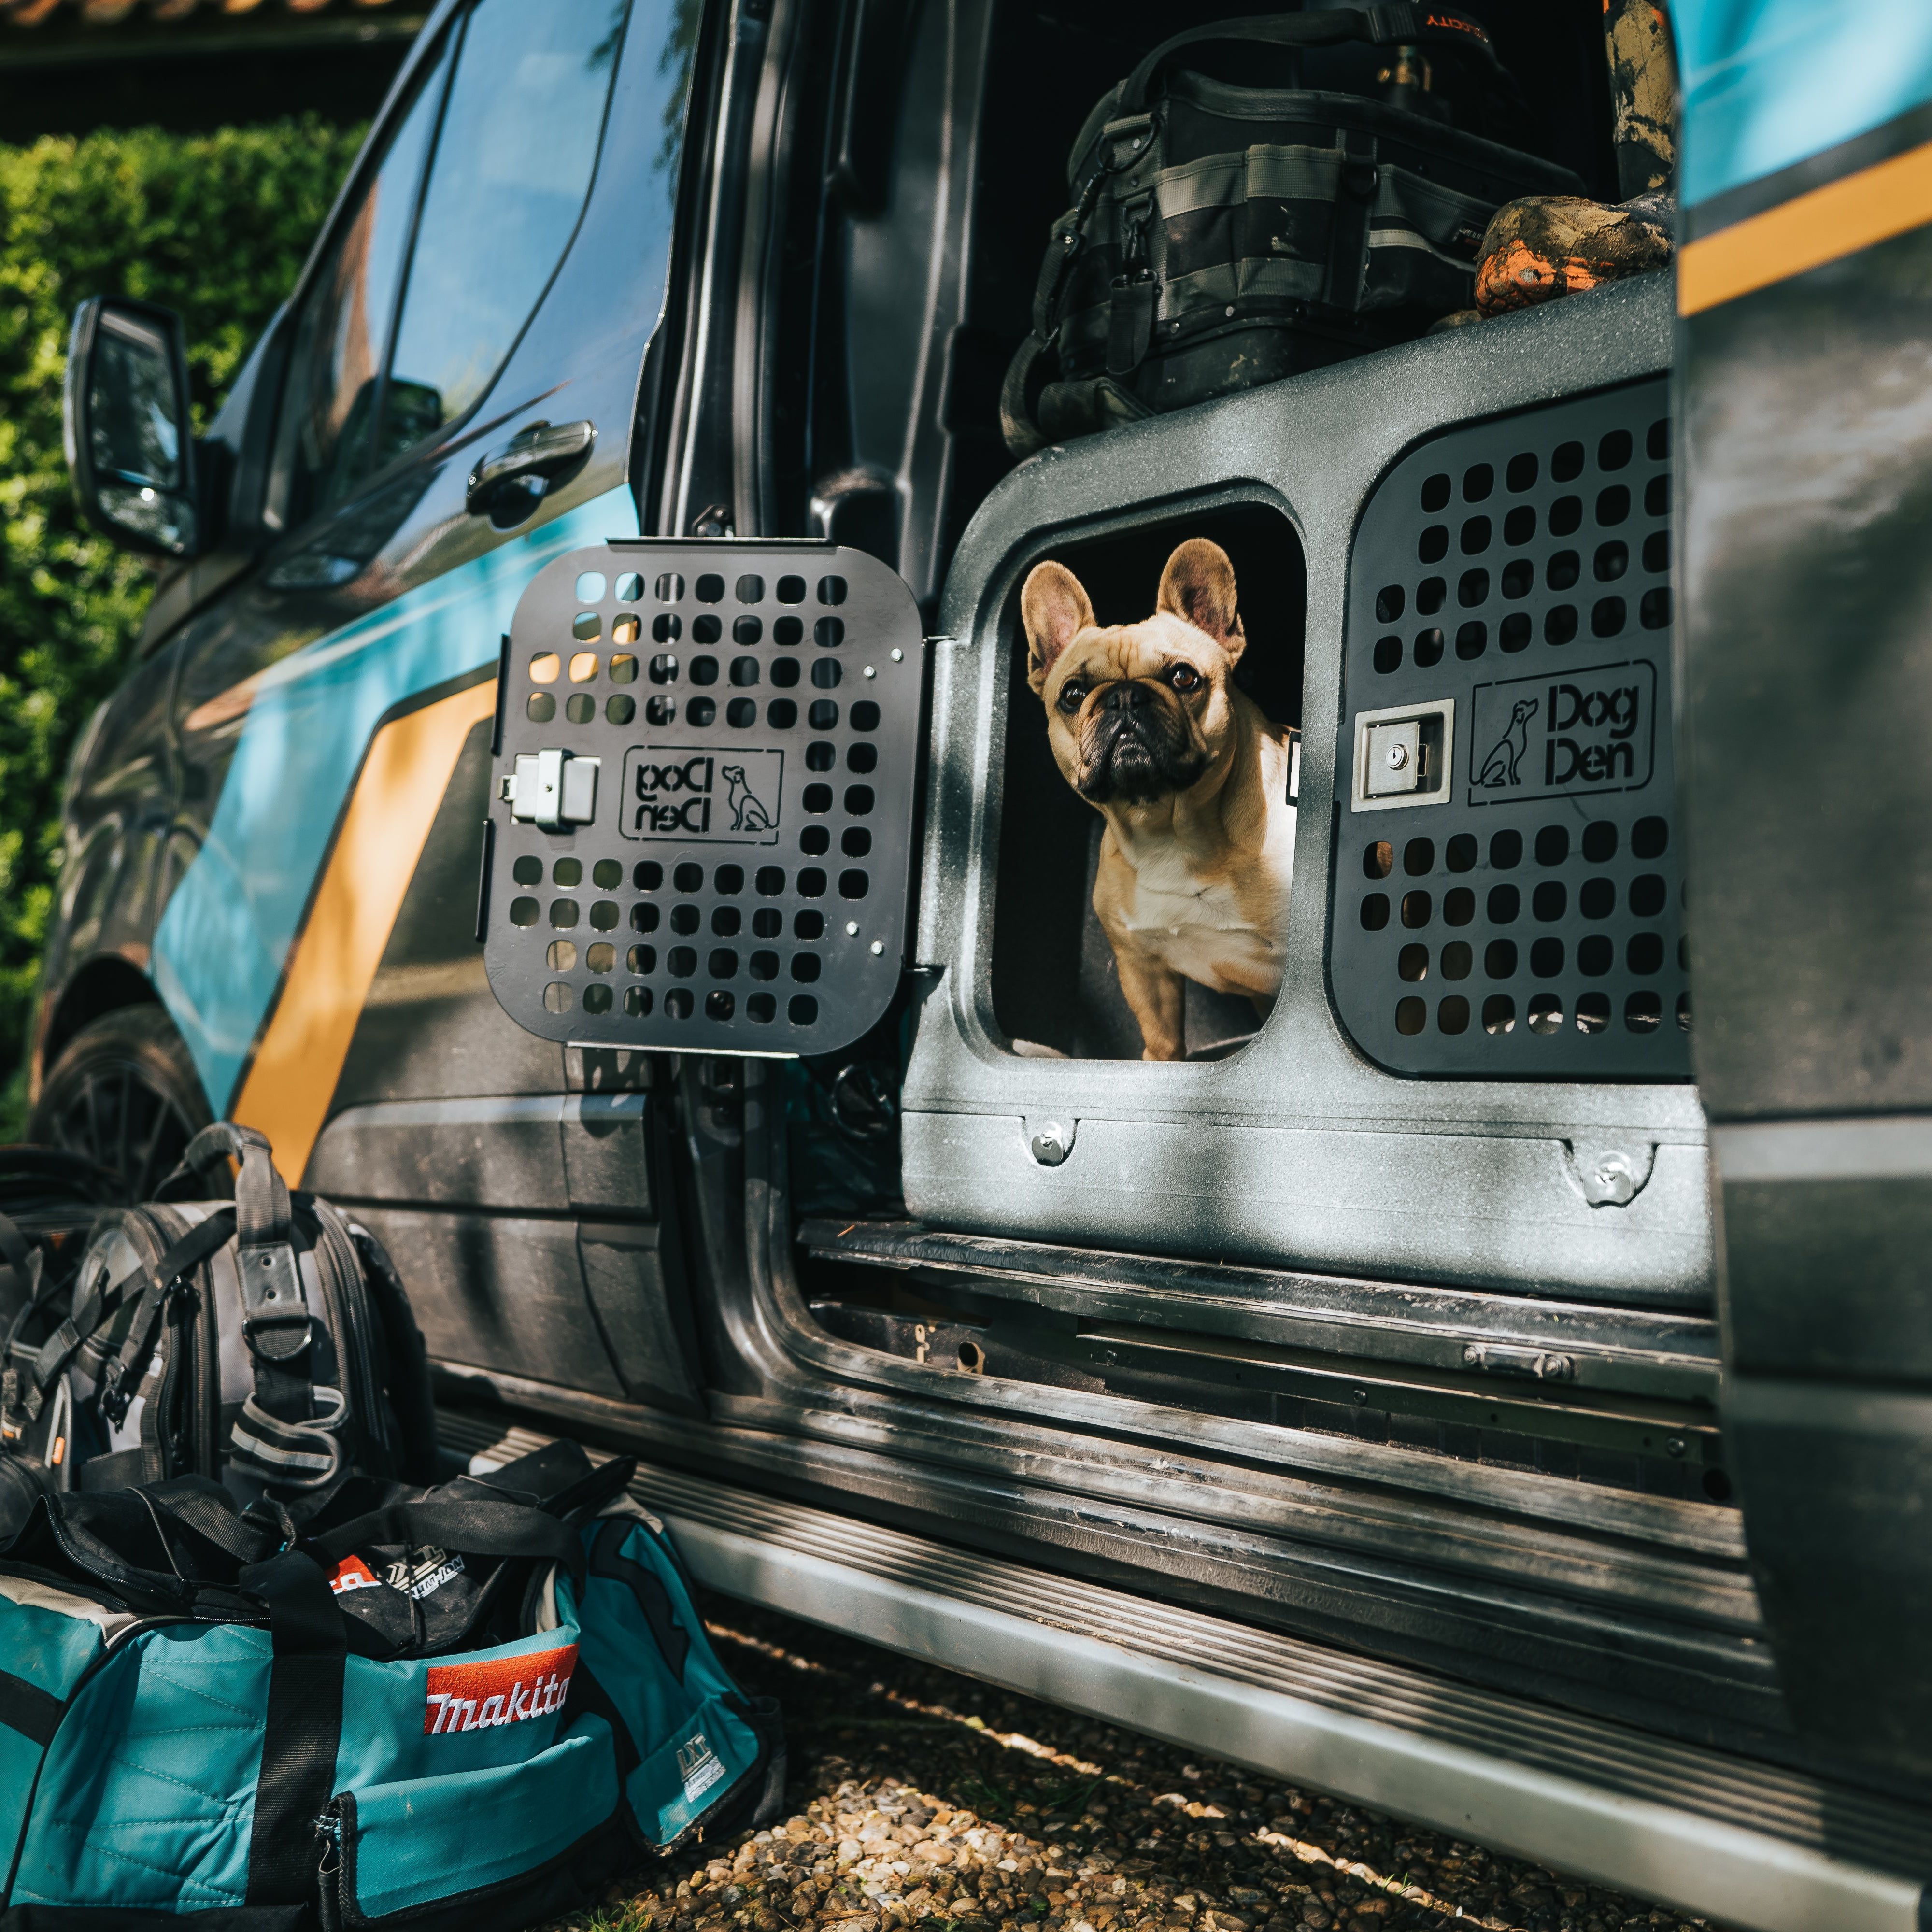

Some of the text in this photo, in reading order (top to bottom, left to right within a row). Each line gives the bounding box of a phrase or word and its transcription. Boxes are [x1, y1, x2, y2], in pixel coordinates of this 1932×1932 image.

[1547, 684, 1639, 739] Dog
[1546, 737, 1634, 786] Den
[427, 1674, 570, 1734] makita
